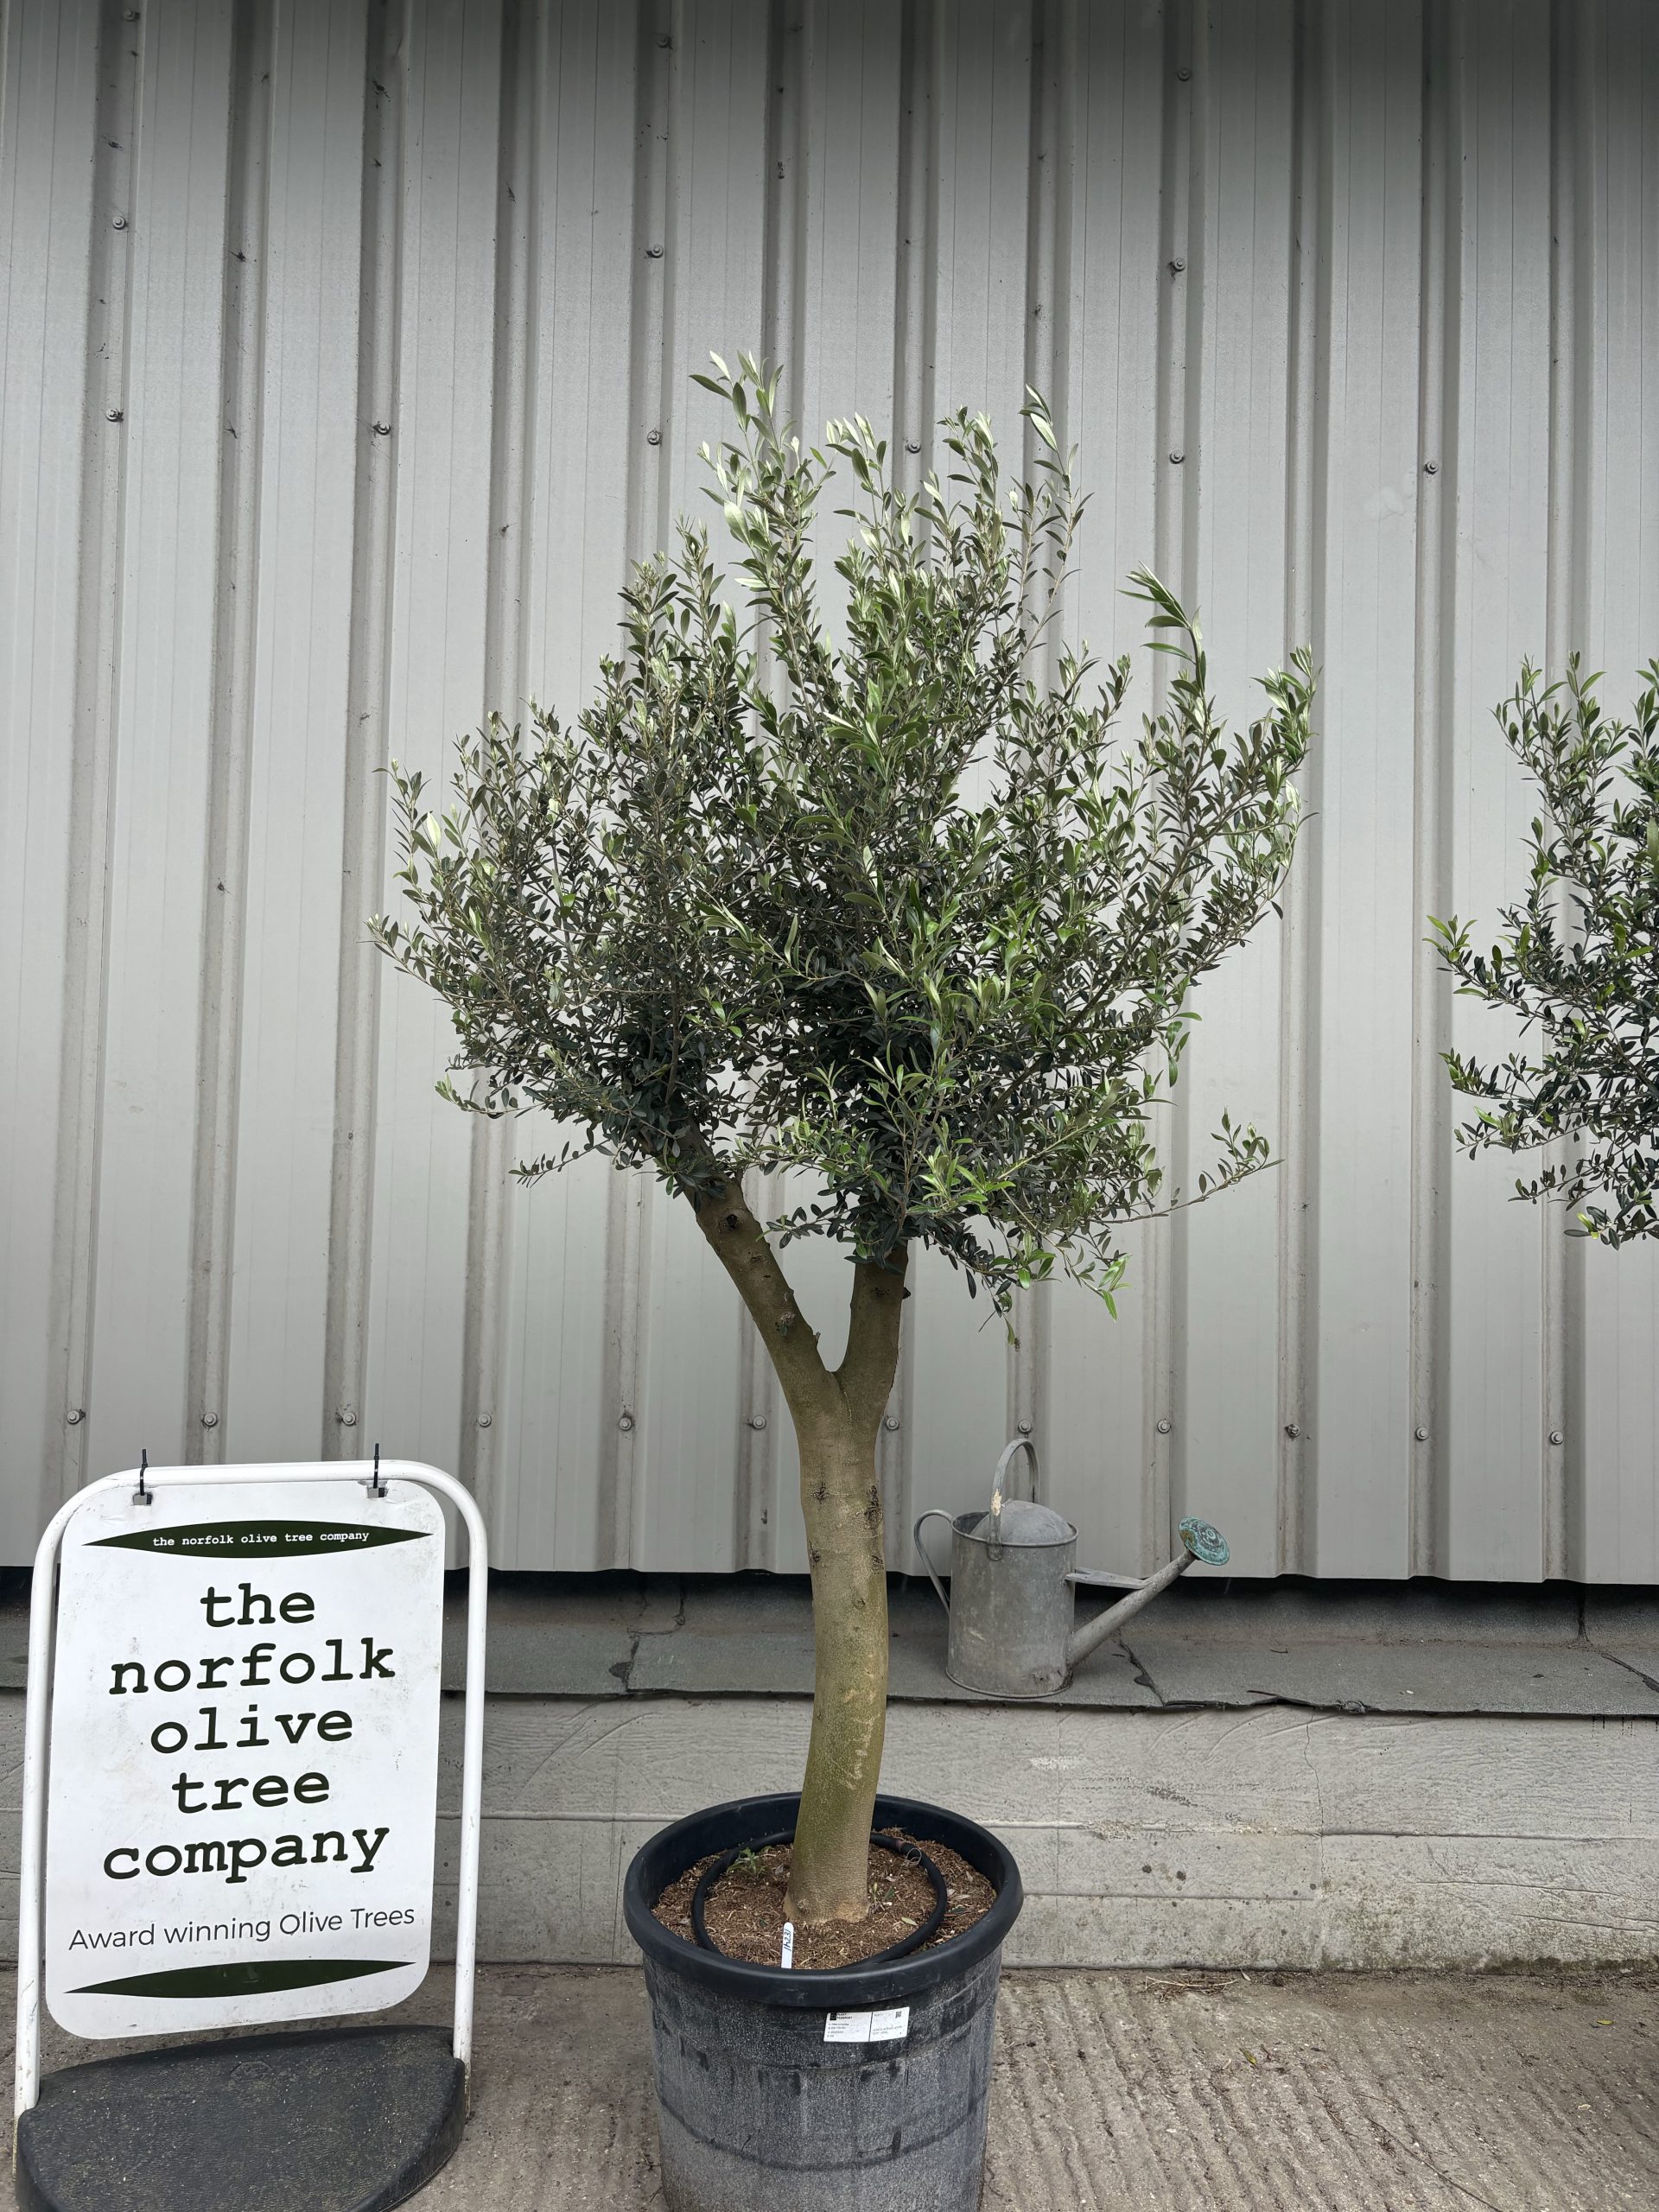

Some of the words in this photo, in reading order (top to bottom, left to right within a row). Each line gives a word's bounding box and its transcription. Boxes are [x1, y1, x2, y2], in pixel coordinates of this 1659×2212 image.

[152, 1536, 175, 1547] the
[181, 1535, 234, 1546] norfolk
[240, 1534, 277, 1543] olive
[284, 1533, 314, 1542] tree
[320, 1531, 370, 1543] company
[200, 1582, 315, 1628] the
[110, 1637, 396, 1695] norfolk
[150, 1703, 353, 1754] olive
[171, 1771, 330, 1814] tree
[103, 1827, 390, 1884] company
[68, 1923, 155, 1951] Award
[163, 1917, 270, 1944] winning
[279, 1911, 343, 1936] Olive
[350, 1905, 415, 1929] Trees
